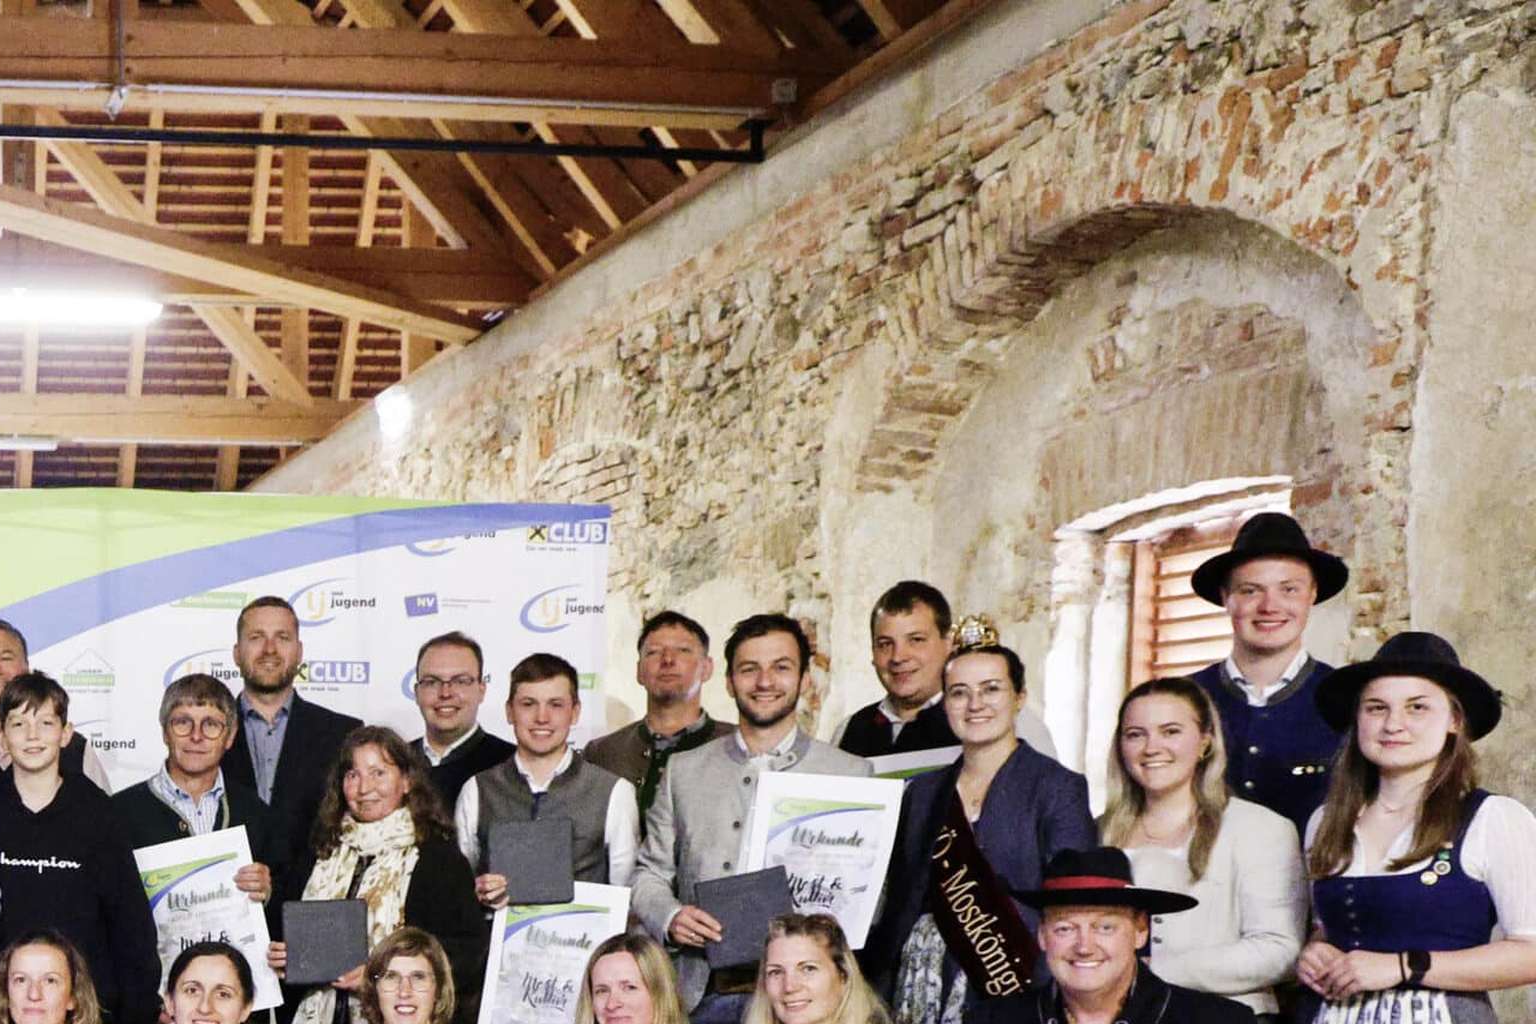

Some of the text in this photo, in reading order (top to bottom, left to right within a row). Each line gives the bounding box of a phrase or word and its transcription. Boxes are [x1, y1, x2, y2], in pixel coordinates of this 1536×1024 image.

[330, 597, 376, 609] jugend
[416, 596, 436, 608] NV
[211, 668, 240, 680] juge
[791, 826, 865, 850] Urkunde
[830, 876, 843, 890] &
[941, 864, 1032, 996] Mostkönigi
[562, 979, 575, 993] &
